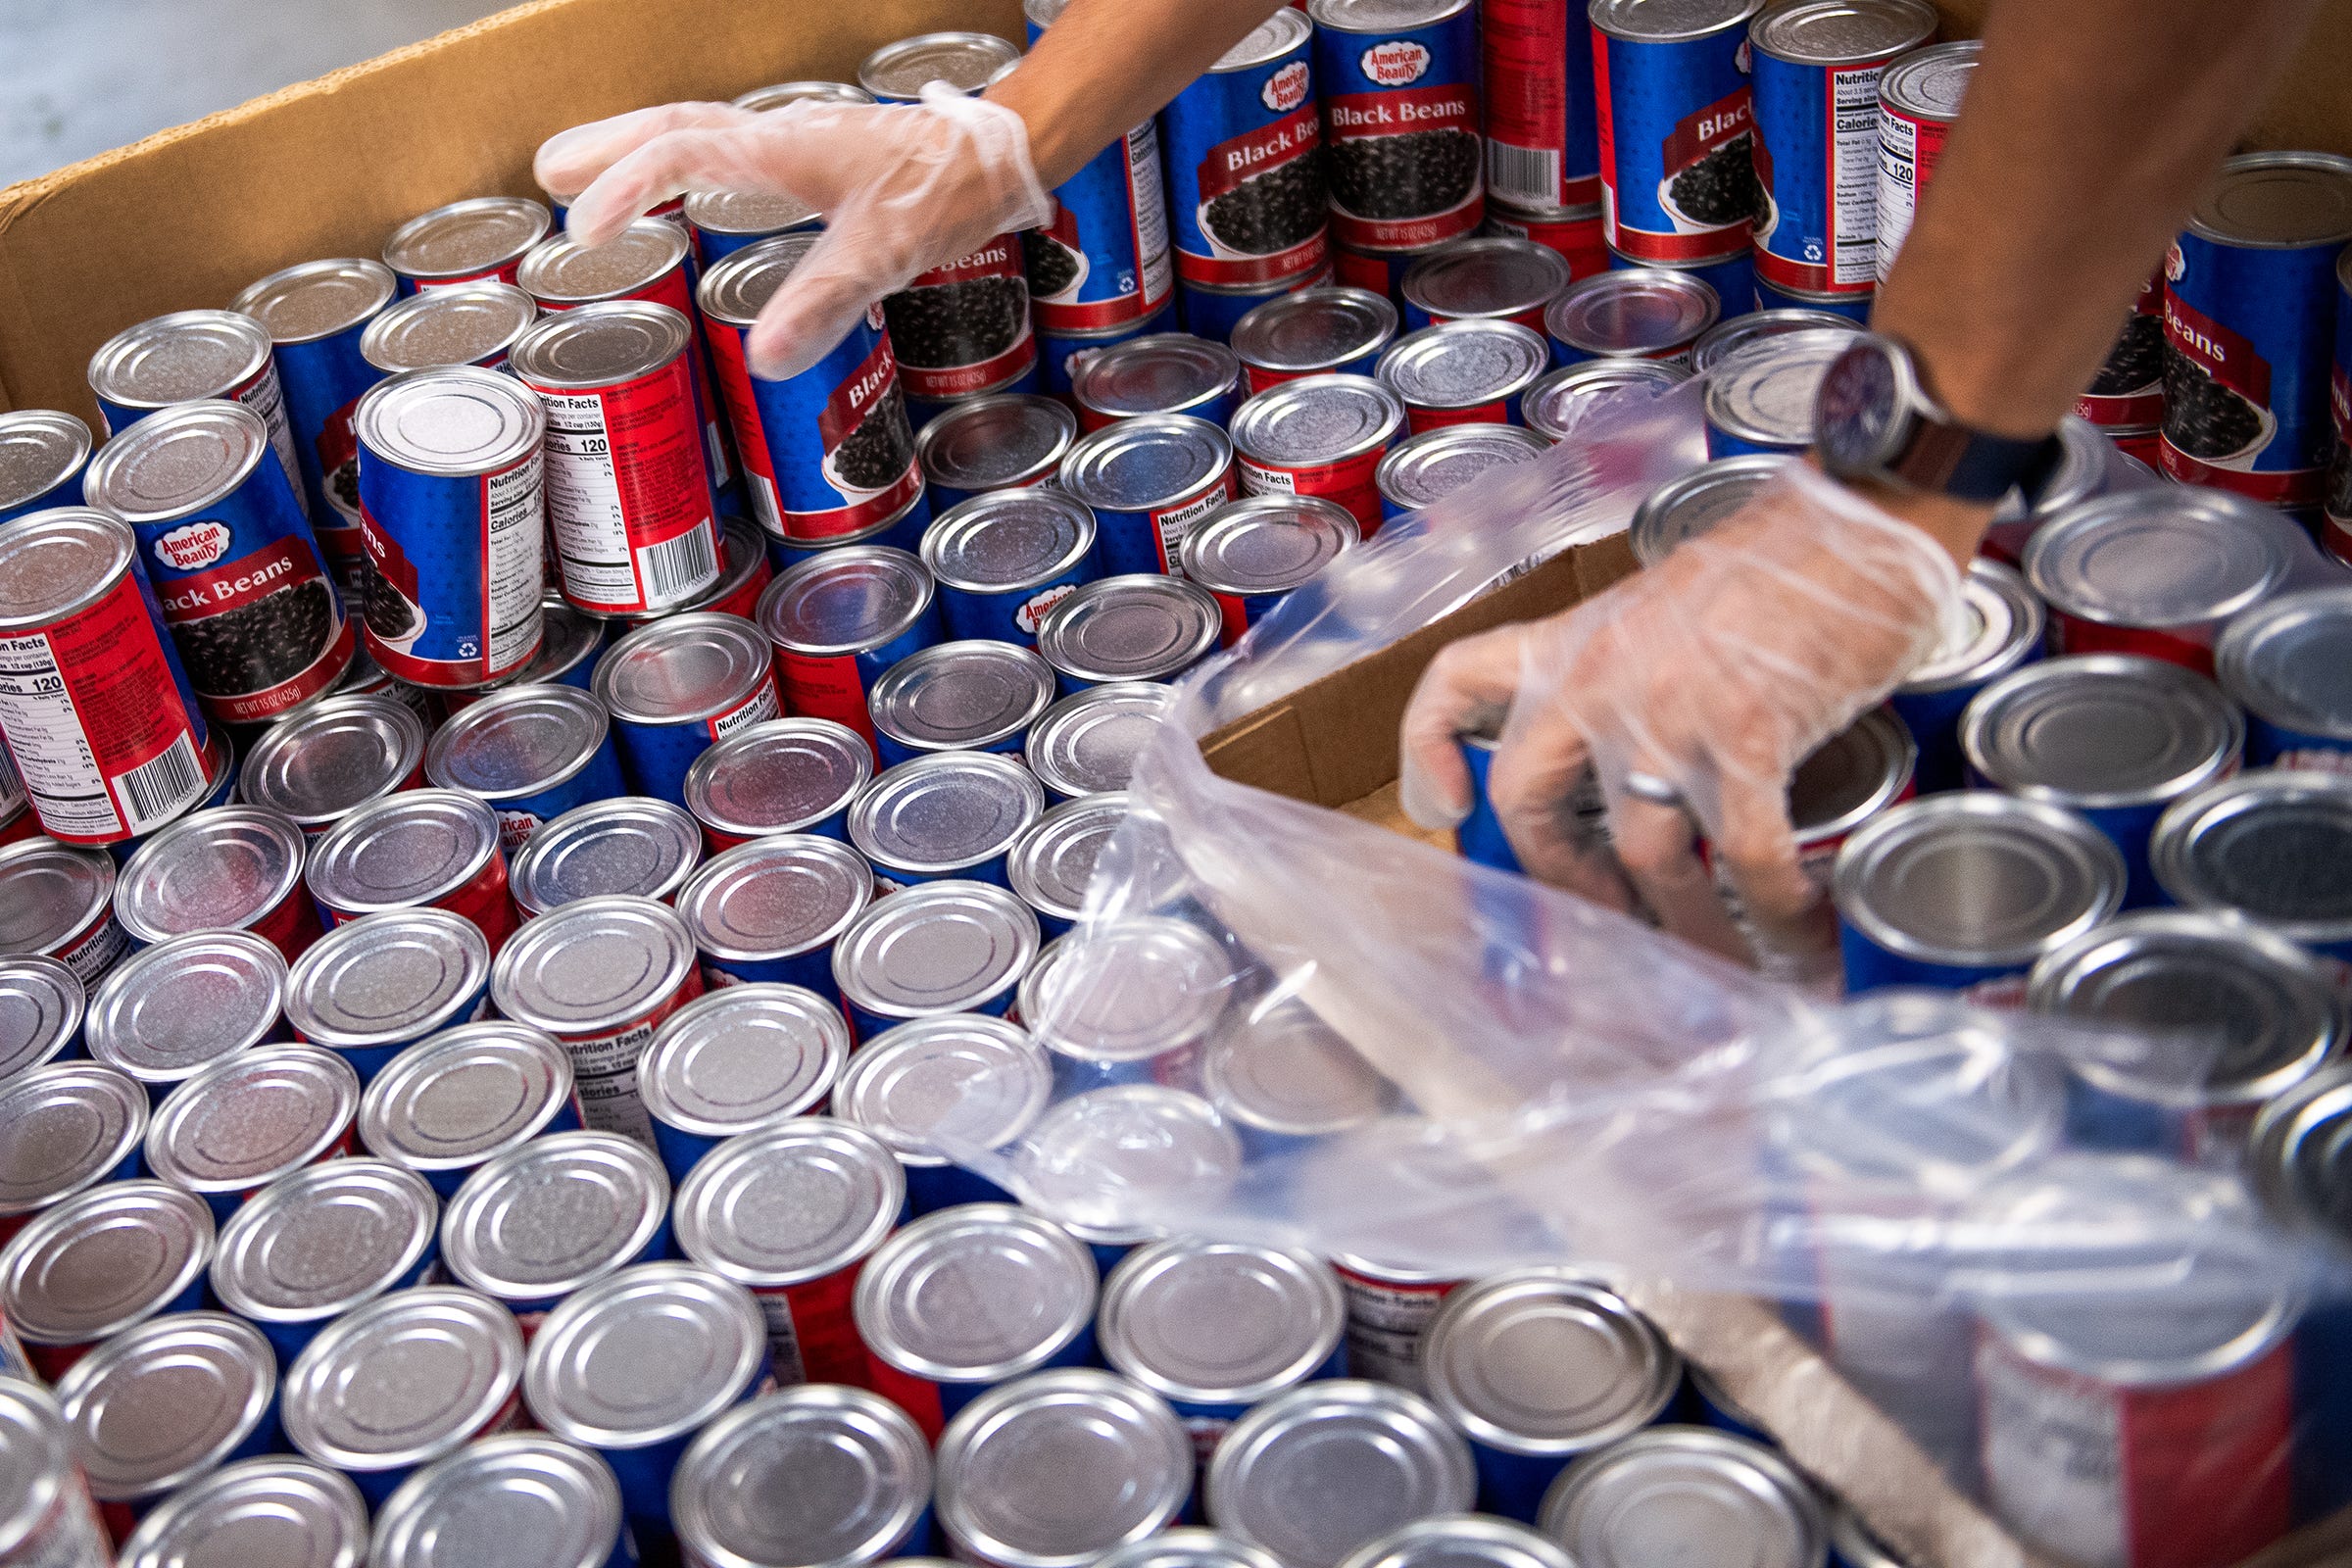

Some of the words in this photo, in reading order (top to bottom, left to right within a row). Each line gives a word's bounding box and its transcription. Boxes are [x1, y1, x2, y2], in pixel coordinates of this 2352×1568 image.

[1371, 48, 1422, 66] American
[1376, 63, 1417, 80] Beauty
[1332, 105, 1394, 126] Black
[1399, 100, 1466, 122] Beans
[1698, 96, 1752, 141] Blac
[1837, 117, 1877, 129] Calorie
[1890, 118, 1913, 136] Facts
[1227, 131, 1294, 172] Black
[1296, 117, 1319, 143] Bea
[1893, 163, 1913, 181] 120
[849, 350, 893, 409] Black
[567, 398, 599, 410] Facts
[581, 438, 607, 452] 120
[490, 465, 529, 490] Nutrition
[1265, 472, 1291, 485] Facts
[1160, 503, 1204, 527] Nutrition
[1205, 488, 1226, 508] Facts
[491, 508, 527, 530] Calories
[162, 526, 220, 555] American
[361, 516, 386, 559] ans
[172, 541, 219, 566] Beauty
[164, 589, 212, 612] ack
[213, 556, 293, 601] Beans
[10, 637, 46, 651] Facts
[33, 658, 54, 669] (130g)
[0, 681, 23, 692] ories
[32, 675, 62, 692] 120
[234, 703, 248, 714] NET
[247, 701, 259, 713] WT
[259, 698, 270, 710] 15
[270, 696, 278, 708] OZ
[279, 685, 301, 707] (425g)
[717, 702, 759, 732] Nutrition
[501, 817, 534, 832] rican
[502, 831, 531, 847] auty
[67, 928, 110, 966] Nutrition
[81, 964, 100, 980] erving
[615, 1028, 650, 1049] Facts
